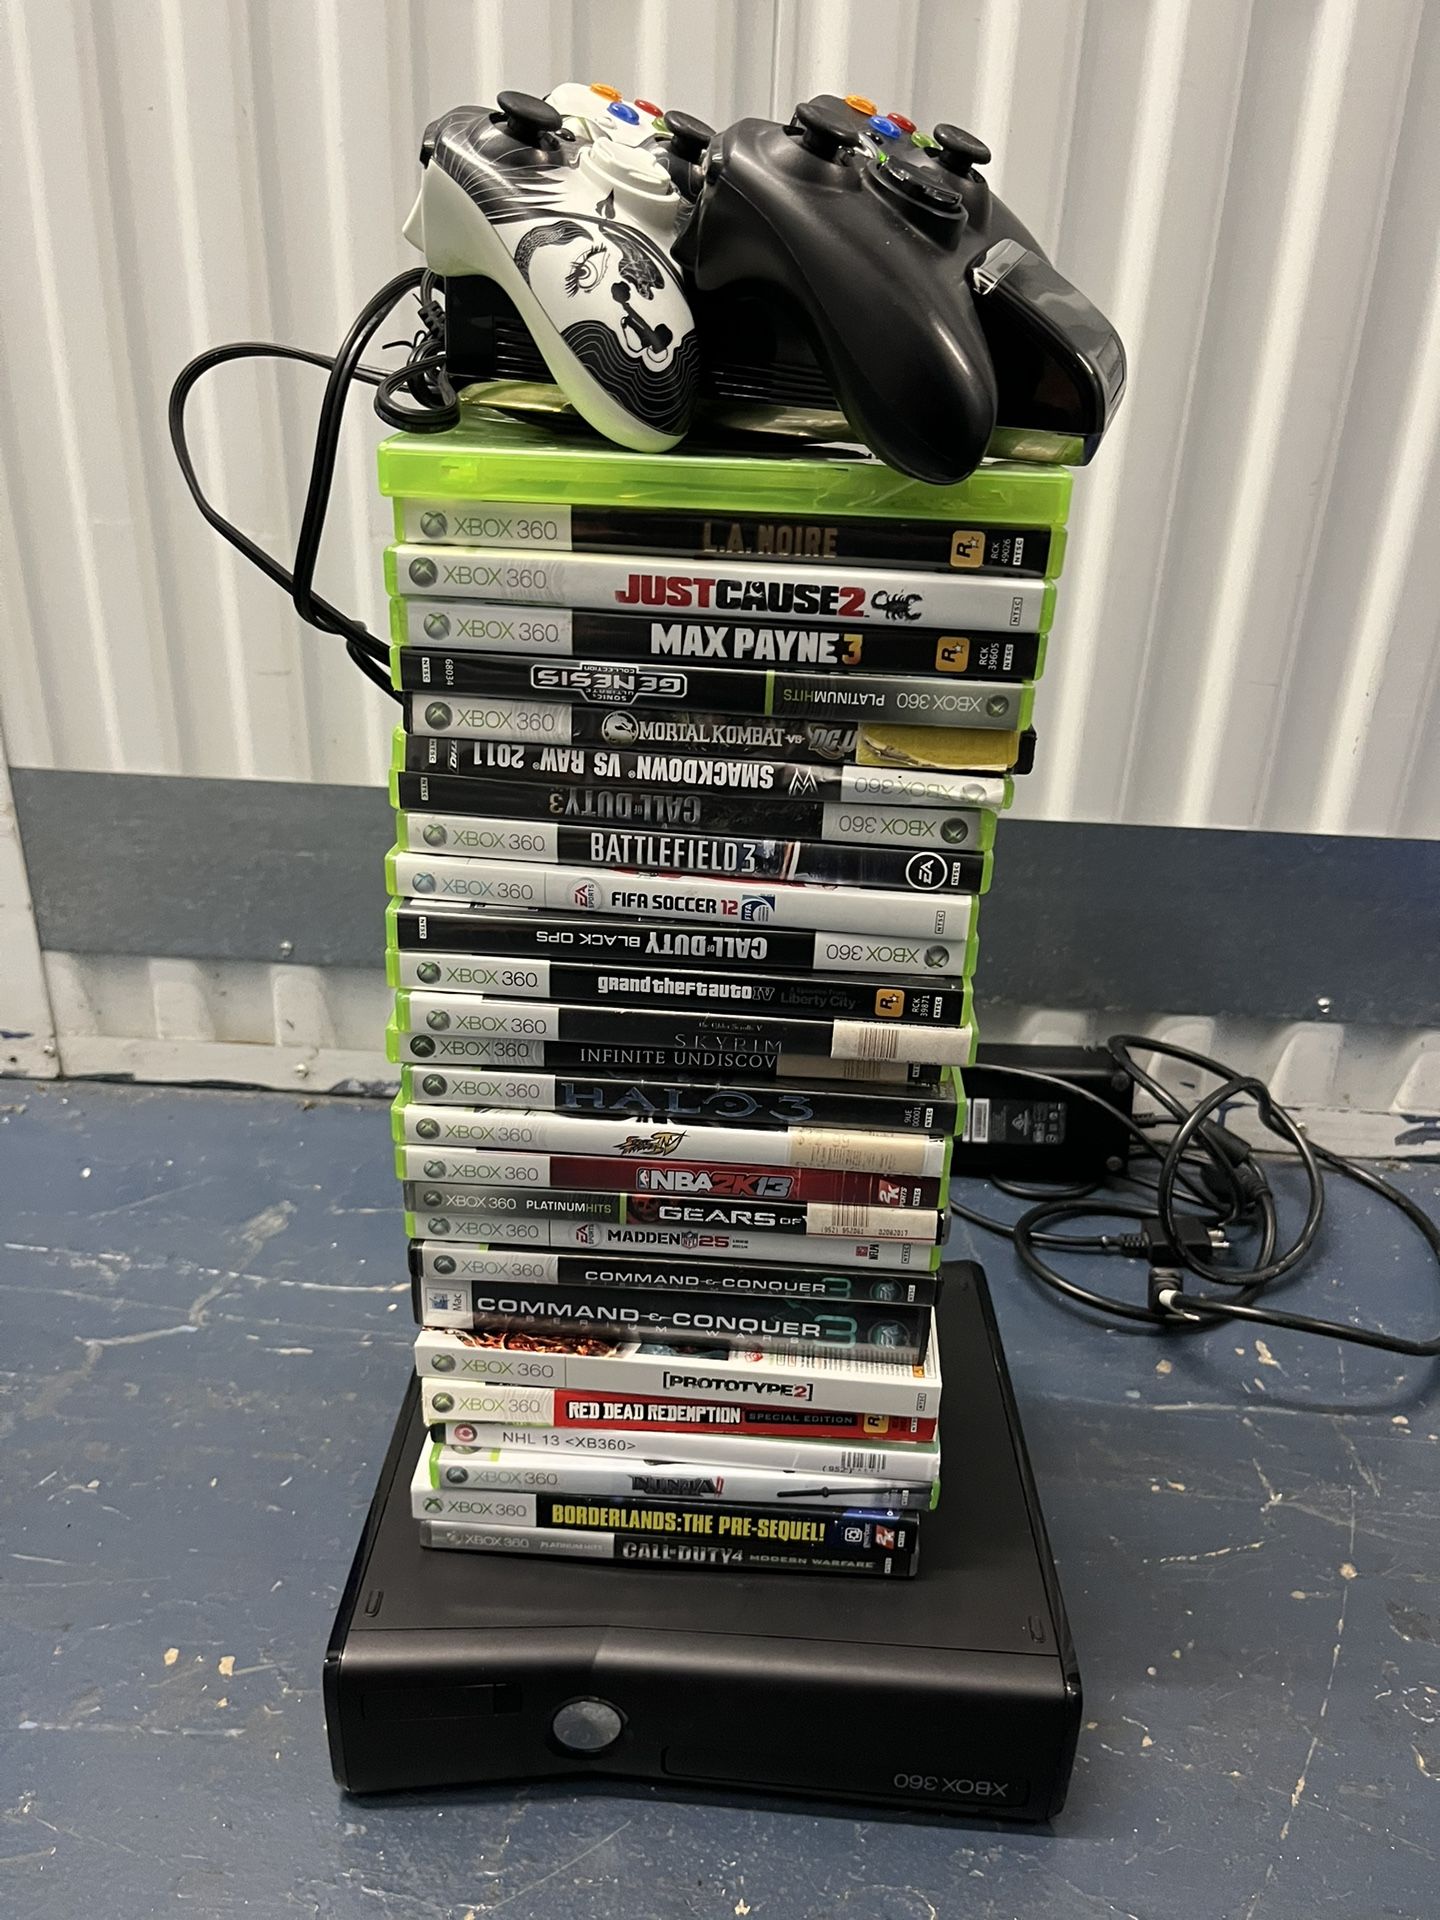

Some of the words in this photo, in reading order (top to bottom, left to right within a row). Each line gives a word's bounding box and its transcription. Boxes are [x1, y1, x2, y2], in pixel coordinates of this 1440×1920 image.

[454, 518, 512, 536] XBOX
[517, 520, 557, 540] 360
[704, 522, 751, 553] L.A.
[758, 524, 838, 558] NOIRE
[991, 542, 999, 559] RCK
[1014, 538, 1023, 565] NTSC
[444, 566, 502, 587] XBOX
[506, 568, 547, 589] 360
[1011, 598, 1022, 625] NTSC
[456, 618, 515, 640] XBOX
[519, 621, 560, 643] 360
[651, 622, 730, 658] MAX
[734, 627, 840, 664] PAYNE
[979, 646, 988, 666] RCK
[1004, 644, 1013, 671] NTSC
[422, 658, 430, 683] NTSC
[584, 665, 635, 674] COLLECTION
[538, 670, 680, 693] GENESIS
[897, 692, 930, 709] 360
[933, 695, 982, 712] XBOX
[457, 709, 513, 729] XBOX
[516, 712, 555, 732] 360
[639, 723, 710, 743] MORTAL
[711, 725, 785, 747] KOMBAT
[473, 741, 524, 769] 2011
[854, 777, 894, 793] 360
[565, 790, 633, 820] DUTY
[644, 794, 700, 824] CALL
[839, 815, 877, 832] 360
[881, 819, 936, 837] XBOX
[453, 830, 505, 848] XBOX
[508, 834, 546, 852] 360
[591, 832, 737, 872] BATTLEFIELD
[741, 844, 756, 873] 3
[951, 862, 961, 886] NTSC
[442, 879, 495, 897] XBOX
[497, 883, 533, 900] 360
[611, 891, 648, 909] FIFA
[652, 894, 717, 914] SOCCER
[720, 900, 738, 916] 12
[936, 911, 945, 934] NTSC
[536, 930, 574, 944] OPS
[579, 933, 640, 948] BLACK
[645, 931, 707, 957] DUTY
[716, 936, 768, 959] CALL
[826, 943, 863, 960] 360
[866, 946, 920, 963] XBOX
[446, 967, 499, 984] XBOX
[501, 970, 538, 987] 360
[781, 991, 827, 1008] Liberty
[829, 994, 857, 1010] City
[912, 997, 920, 1014] RCK
[934, 997, 943, 1018] NTSC
[456, 1015, 508, 1032] XBOX
[510, 1018, 546, 1034] 360
[440, 1040, 490, 1056] XBOX
[494, 1041, 529, 1058] 360
[674, 1034, 782, 1054] SKYRIM
[580, 1048, 665, 1065] INFINITE
[452, 1080, 503, 1096] XBOX
[505, 1083, 540, 1099] 360
[561, 1082, 762, 1118] HALO
[769, 1095, 814, 1121] 3
[925, 1108, 933, 1128] NTSC
[445, 1125, 495, 1140] XBOX
[498, 1127, 533, 1142] 360
[451, 1164, 500, 1179] XBOX
[504, 1166, 539, 1181] 360
[446, 1194, 486, 1208] XBOX
[488, 1197, 517, 1209] 360
[659, 1206, 776, 1226] GEARS
[779, 1218, 802, 1226] OF
[455, 1222, 503, 1236] XBOX
[506, 1224, 539, 1238] 360
[607, 1229, 680, 1246] MADDEN
[699, 1235, 730, 1248] 25
[461, 1260, 508, 1274] XBOX
[511, 1263, 544, 1277] 360
[585, 1271, 699, 1286] COMMAND
[722, 1278, 826, 1294] CONQUER
[453, 1293, 462, 1311] Mac
[477, 1298, 640, 1321] COMMAND
[672, 1312, 820, 1338] CONQUER
[462, 1358, 514, 1375] XBOX
[517, 1362, 554, 1377] 360
[458, 1398, 505, 1411] XBOX
[508, 1399, 540, 1413] 360
[568, 1401, 600, 1420] RED
[603, 1403, 644, 1421] DEAD
[648, 1404, 741, 1424] REDEMPTION
[749, 1413, 800, 1422] SPECIAL
[804, 1415, 853, 1424] EDITION
[503, 1431, 536, 1444] NHL
[542, 1434, 560, 1446] 13
[565, 1438, 636, 1451] <XB360>
[473, 1470, 523, 1485] XBOX
[525, 1472, 558, 1486] 360
[447, 1503, 493, 1515] XBOX
[496, 1504, 527, 1517] 360
[718, 1516, 826, 1542] PRE-SEQUEL!
[465, 1534, 501, 1546] XBOX
[503, 1537, 530, 1548] 360
[622, 1542, 670, 1560] CALL
[678, 1546, 732, 1563] DUTY
[750, 1555, 807, 1565] MODERN
[812, 1558, 875, 1569] WARFARE
[894, 1773, 938, 1791] 360
[942, 1778, 1009, 1798] XBOX
